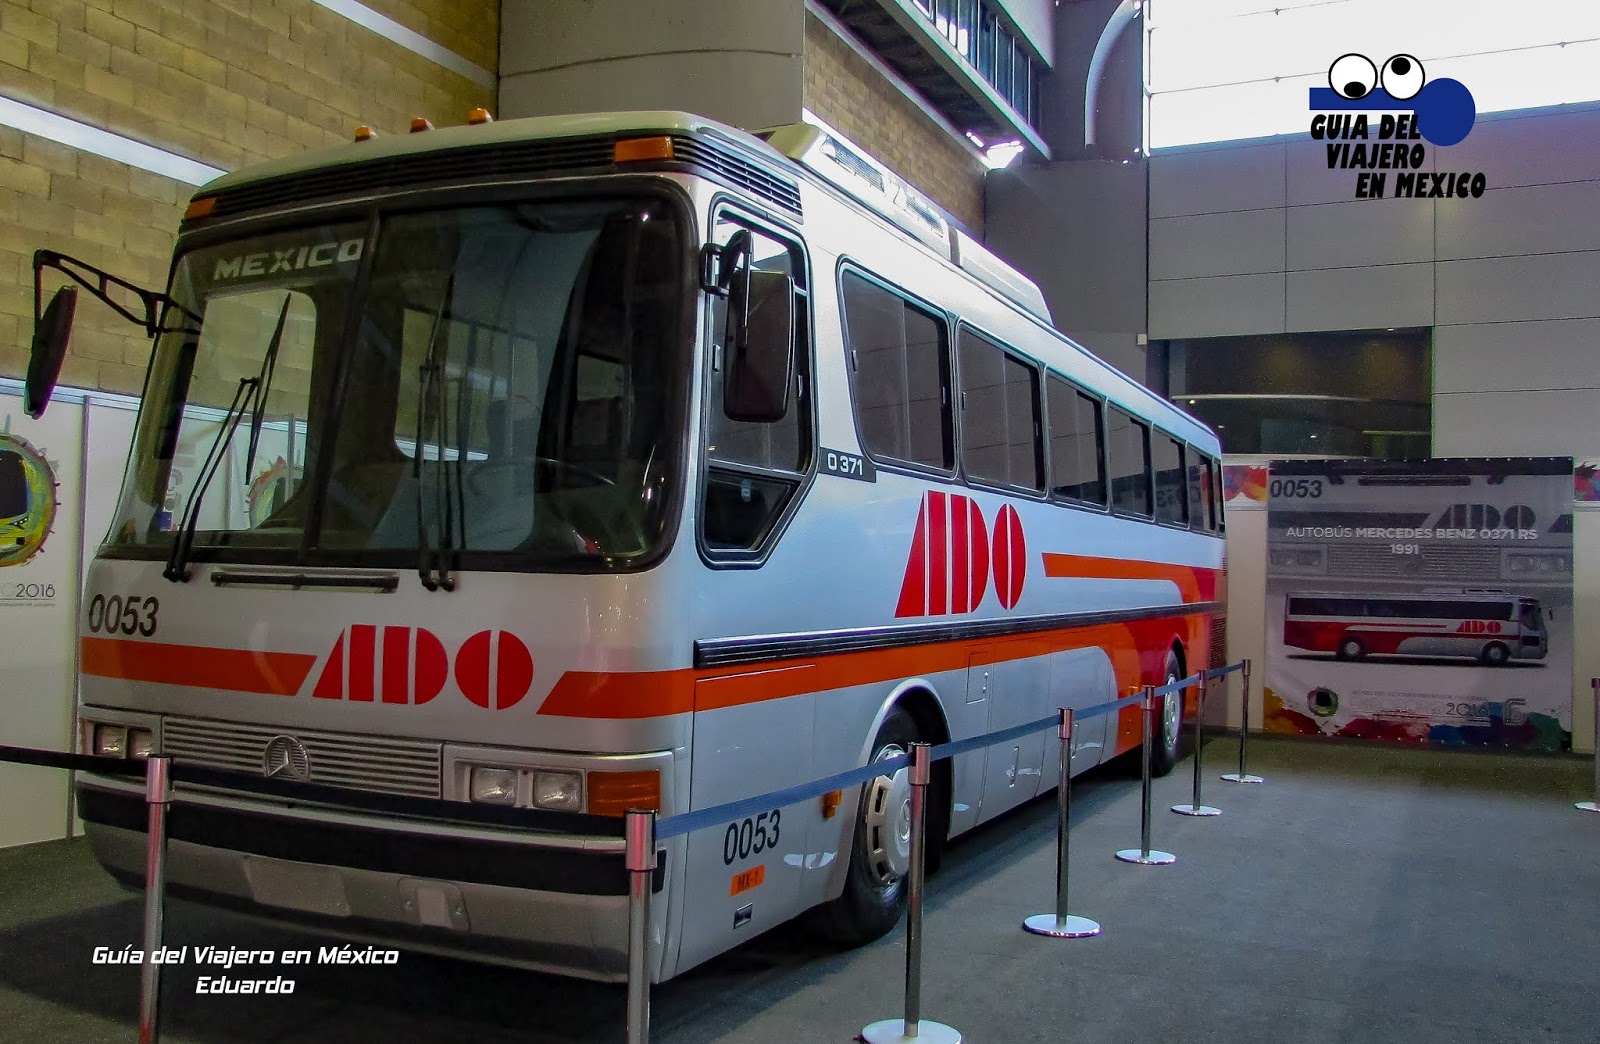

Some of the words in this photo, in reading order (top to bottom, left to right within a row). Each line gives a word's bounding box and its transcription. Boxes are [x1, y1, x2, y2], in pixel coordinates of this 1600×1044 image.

[213, 239, 364, 280] MEXICO
[840, 455, 863, 476] 371
[1270, 479, 1323, 499] 0053
[1433, 504, 1536, 530] ADO
[1286, 525, 1353, 539] AUTOBÚS
[1355, 527, 1433, 539] MERCEDES
[1436, 528, 1476, 539] BENZ
[1517, 529, 1538, 540] RS
[894, 490, 1027, 619] ADO
[1389, 543, 1420, 555] 1991
[88, 594, 159, 637] 0053
[1456, 620, 1501, 634] ADO
[313, 624, 534, 710] ADO
[723, 809, 781, 866] 0053
[736, 869, 759, 894] MX-1
